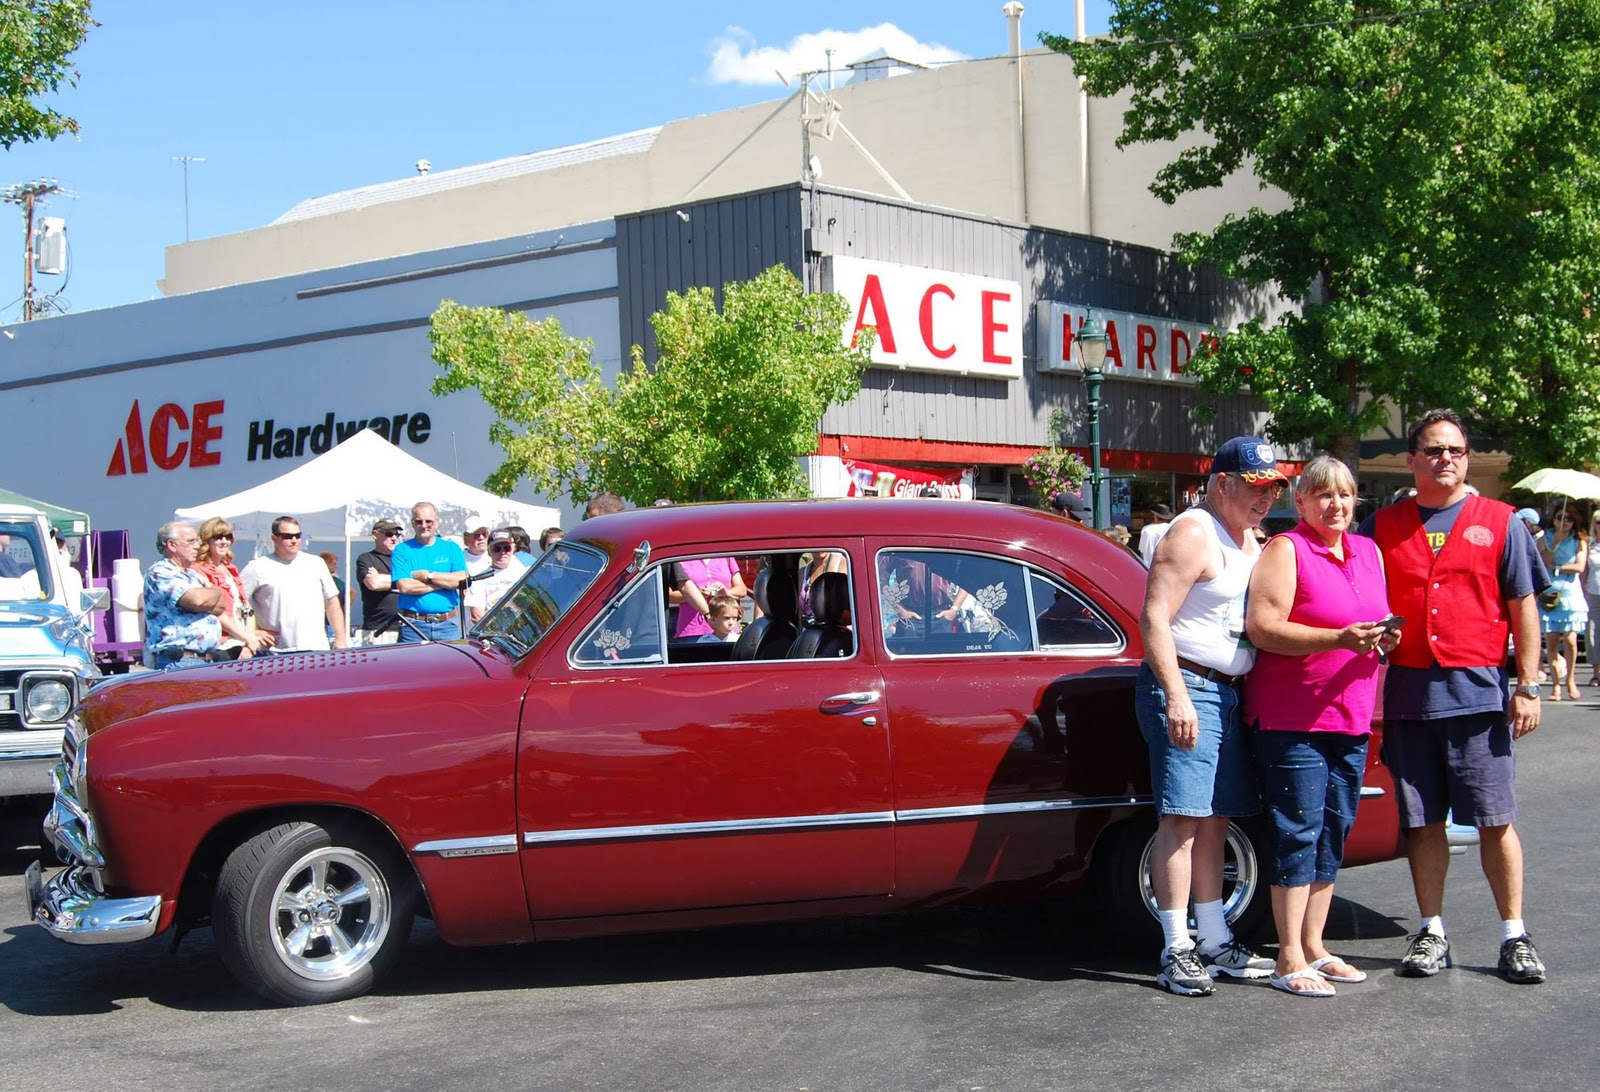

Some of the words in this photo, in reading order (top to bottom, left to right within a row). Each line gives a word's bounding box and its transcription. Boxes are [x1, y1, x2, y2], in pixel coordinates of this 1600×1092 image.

[851, 273, 1012, 365] ACE
[1062, 313, 1219, 375] HARD
[106, 399, 225, 476] ACE
